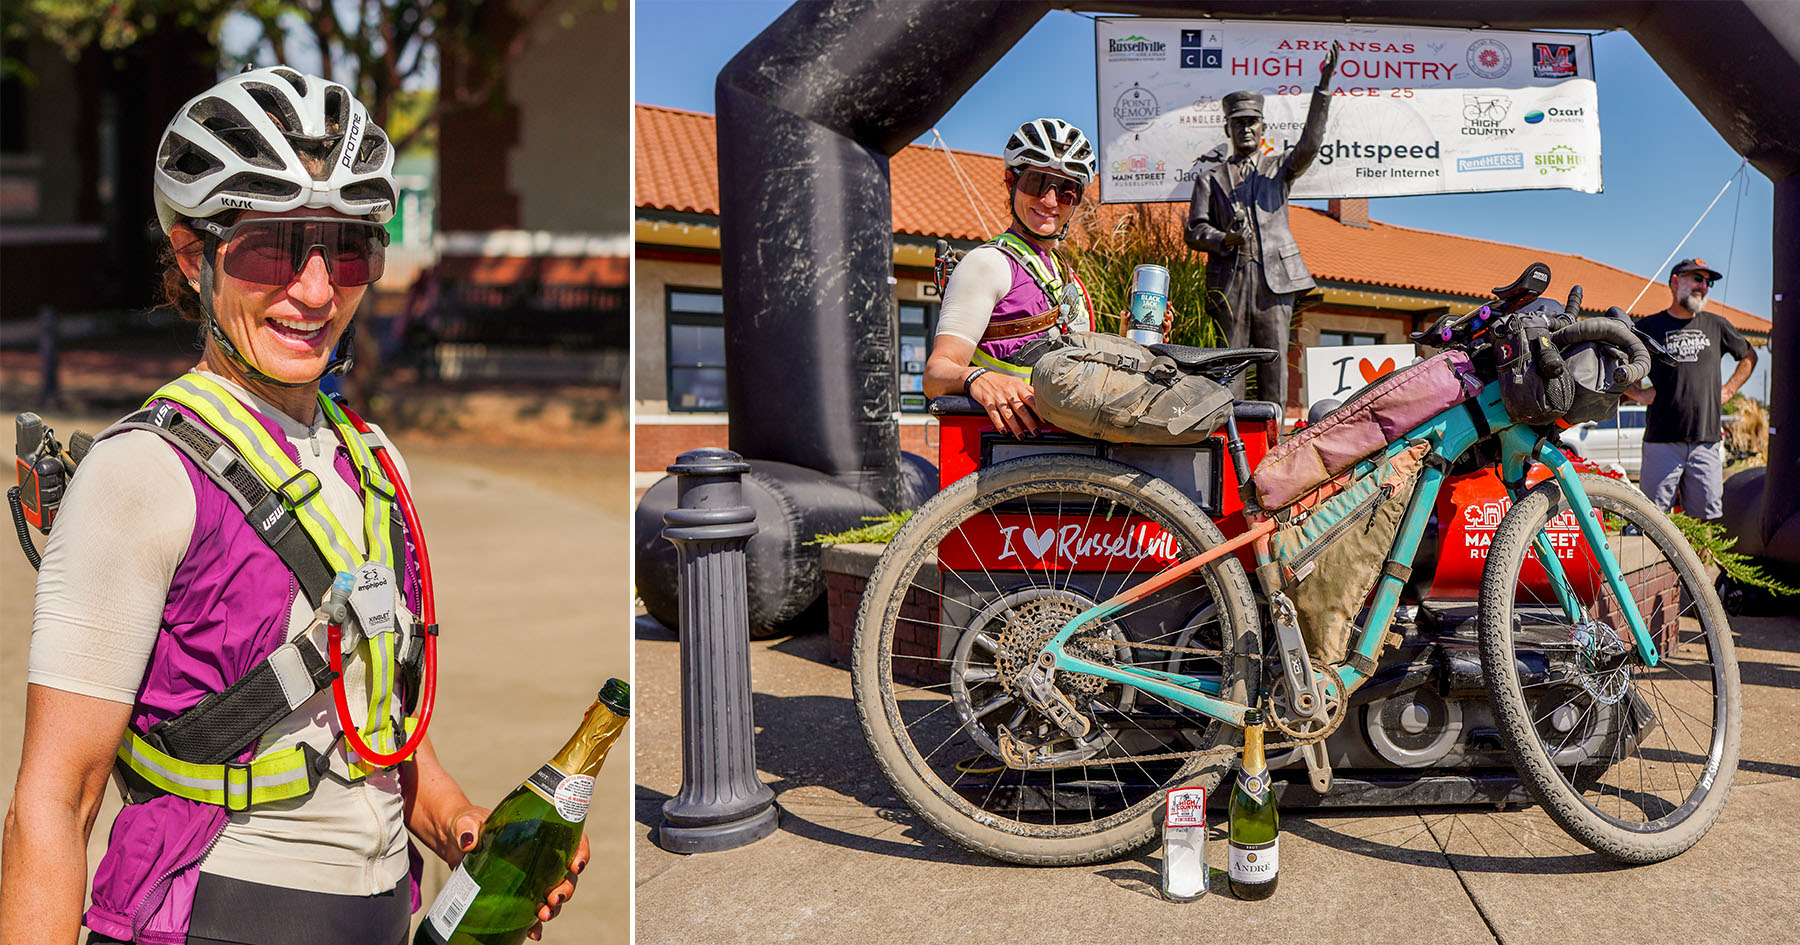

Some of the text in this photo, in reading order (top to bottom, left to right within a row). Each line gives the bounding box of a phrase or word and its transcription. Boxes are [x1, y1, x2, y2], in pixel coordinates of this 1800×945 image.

[1108, 38, 1167, 53] Russellville
[1232, 57, 1459, 81] HIGH OUNTRY
[1277, 85, 1415, 99] 20 ACE 25
[1122, 99, 1152, 108] POINT
[1113, 106, 1161, 120] REMOVE
[1471, 119, 1500, 128] HIGH
[1461, 127, 1516, 136] COUNTRY
[1534, 155, 1564, 166] SIGN
[1111, 172, 1166, 182] MAIN STREET
[1355, 167, 1440, 179] Fiber Internet
[220, 197, 254, 210] KASK
[1141, 294, 1161, 303] BLACK
[358, 579, 388, 592] amphipod
